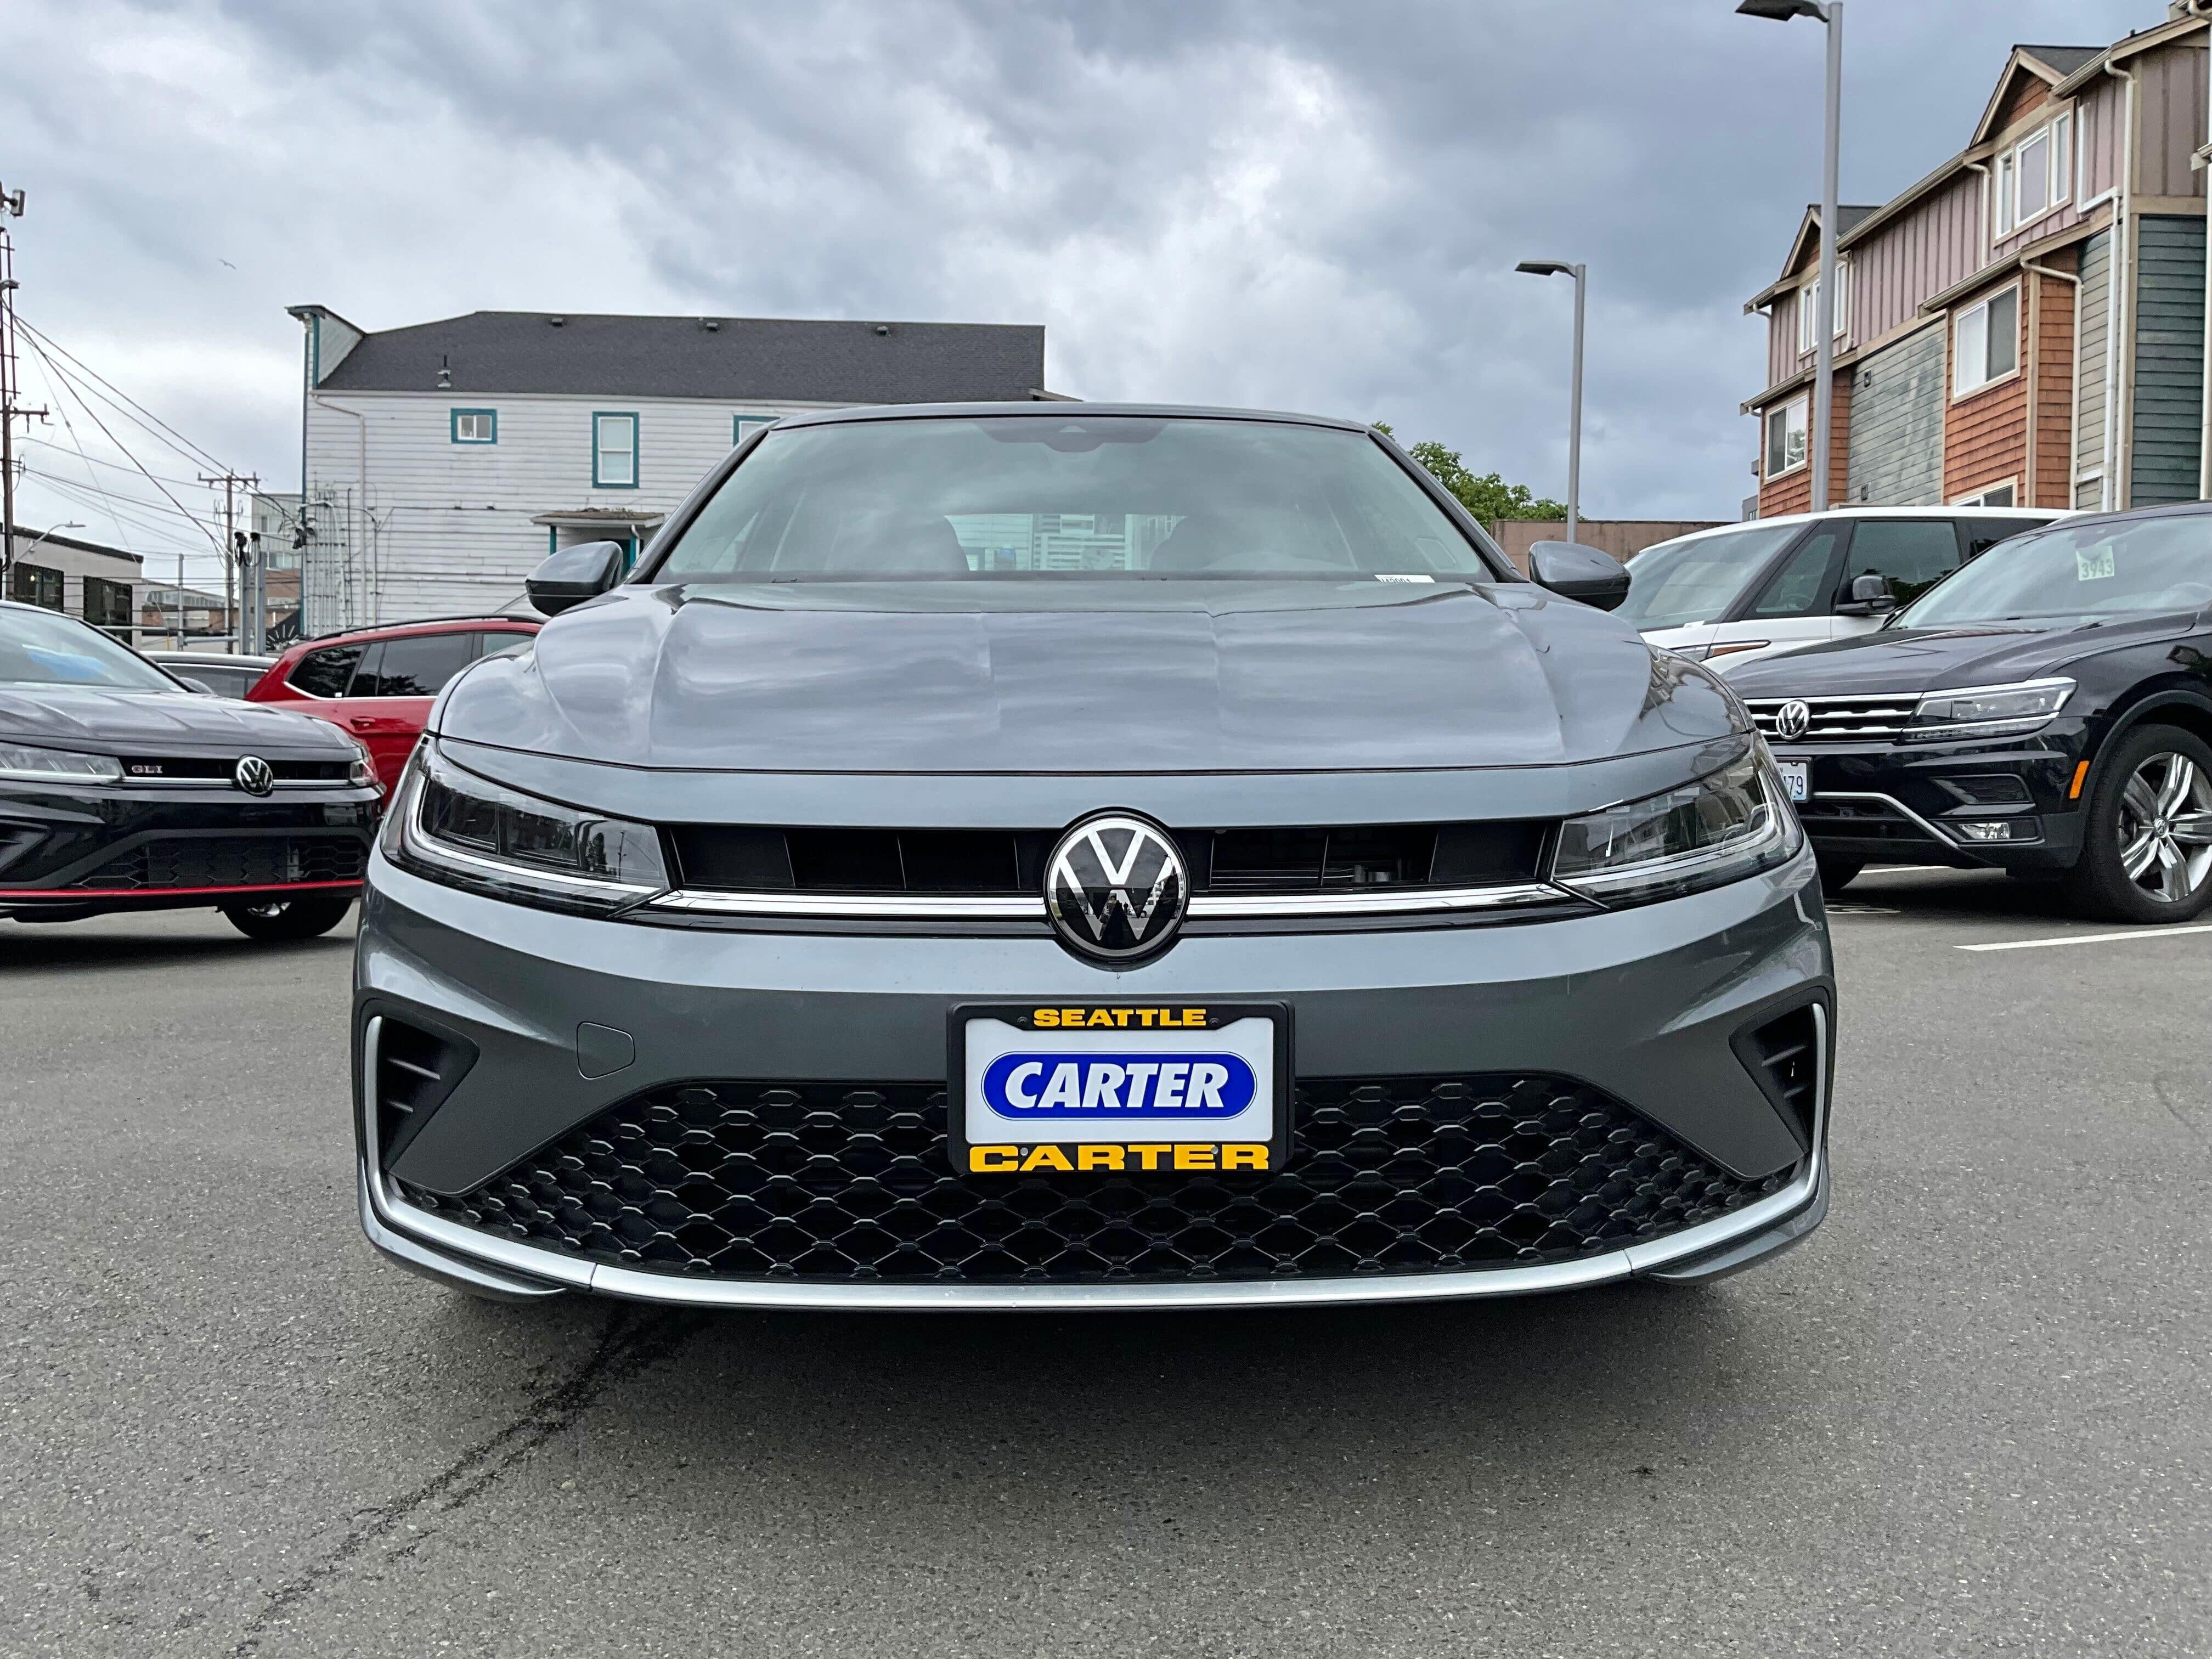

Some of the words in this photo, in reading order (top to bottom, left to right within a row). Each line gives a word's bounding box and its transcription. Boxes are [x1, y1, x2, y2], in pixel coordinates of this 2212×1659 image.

[131, 765, 163, 774] GLI
[1784, 775, 1803, 797] 79
[1034, 1009, 1206, 1026] SEATTLE
[1005, 1062, 1228, 1108] CARTER
[969, 1144, 1269, 1172] CARTER
